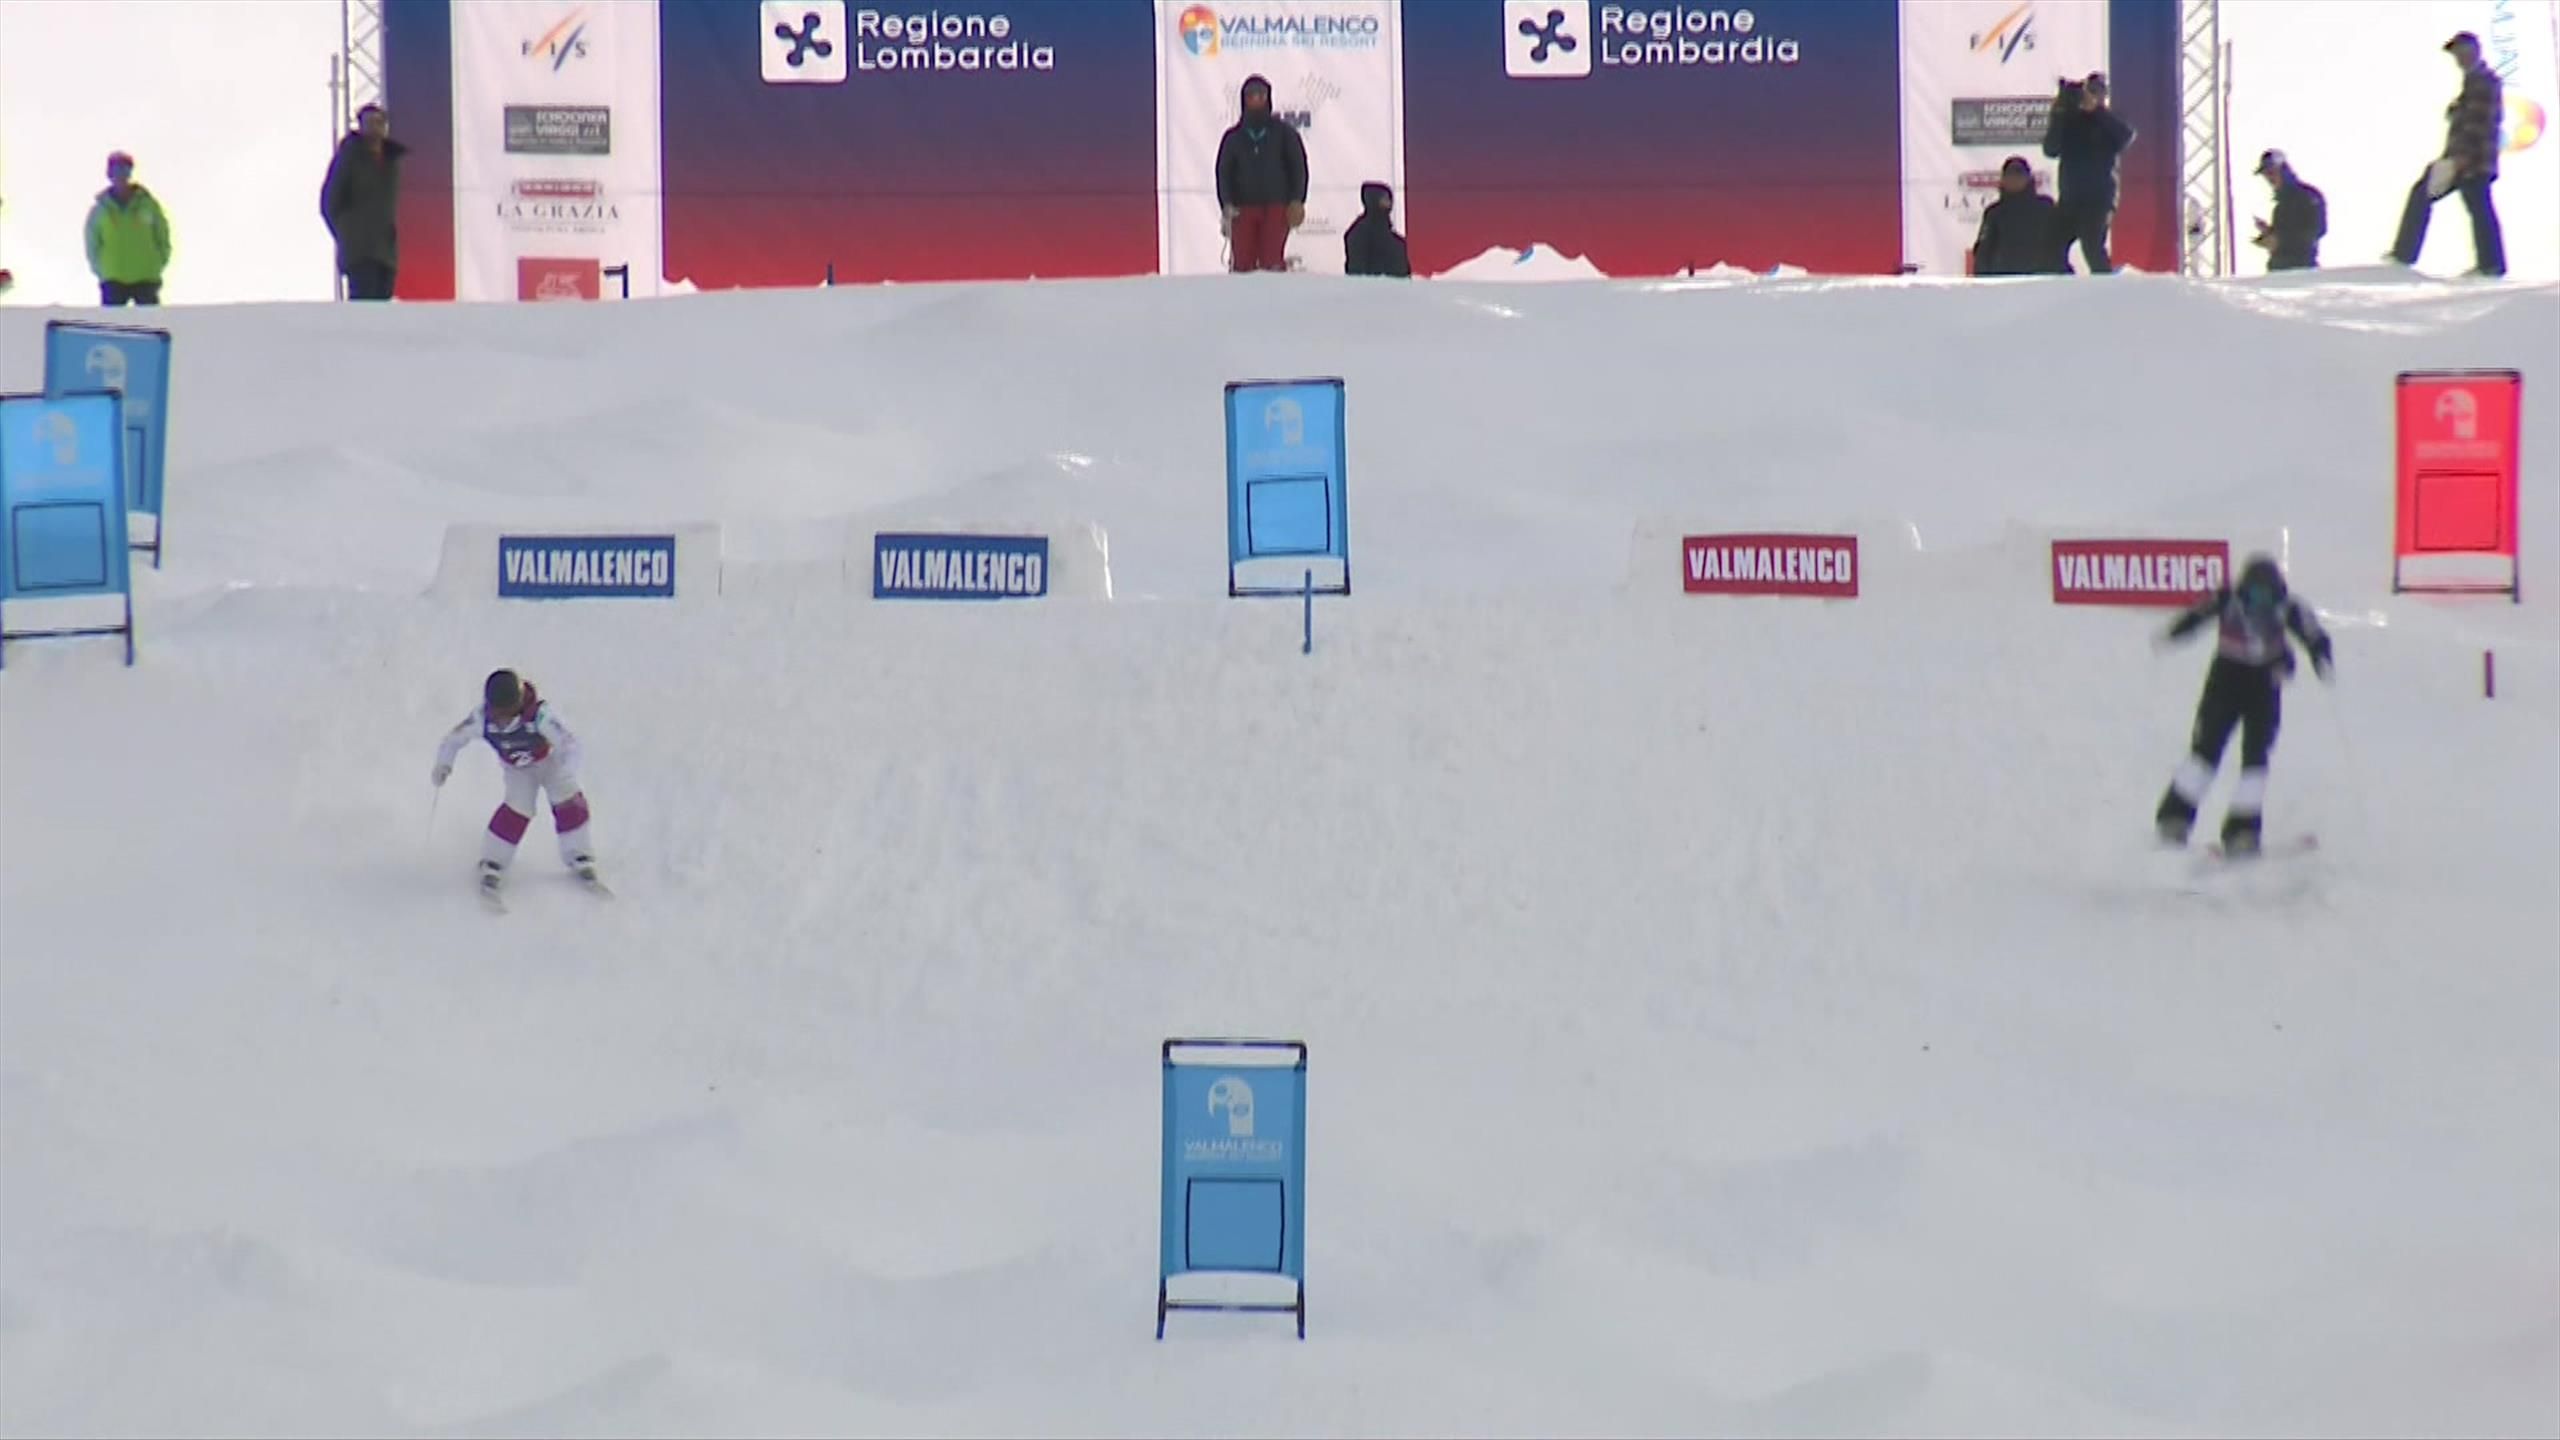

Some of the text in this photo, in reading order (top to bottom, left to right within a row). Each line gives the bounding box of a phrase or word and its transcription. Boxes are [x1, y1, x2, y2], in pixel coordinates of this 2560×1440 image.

[857, 9, 1010, 45] Regione
[1219, 14, 1379, 34] VALMALENCO
[1601, 5, 1754, 40] Regione
[858, 41, 1054, 70] Lombardia
[1602, 36, 1799, 64] Lombardia
[532, 204, 619, 219] GRAZIA
[505, 549, 669, 586] VALMALENCO
[880, 550, 1041, 594] VALMALENCO
[1689, 548, 1852, 583] VALMALENCO
[2058, 554, 2223, 592] VALMALENCO
